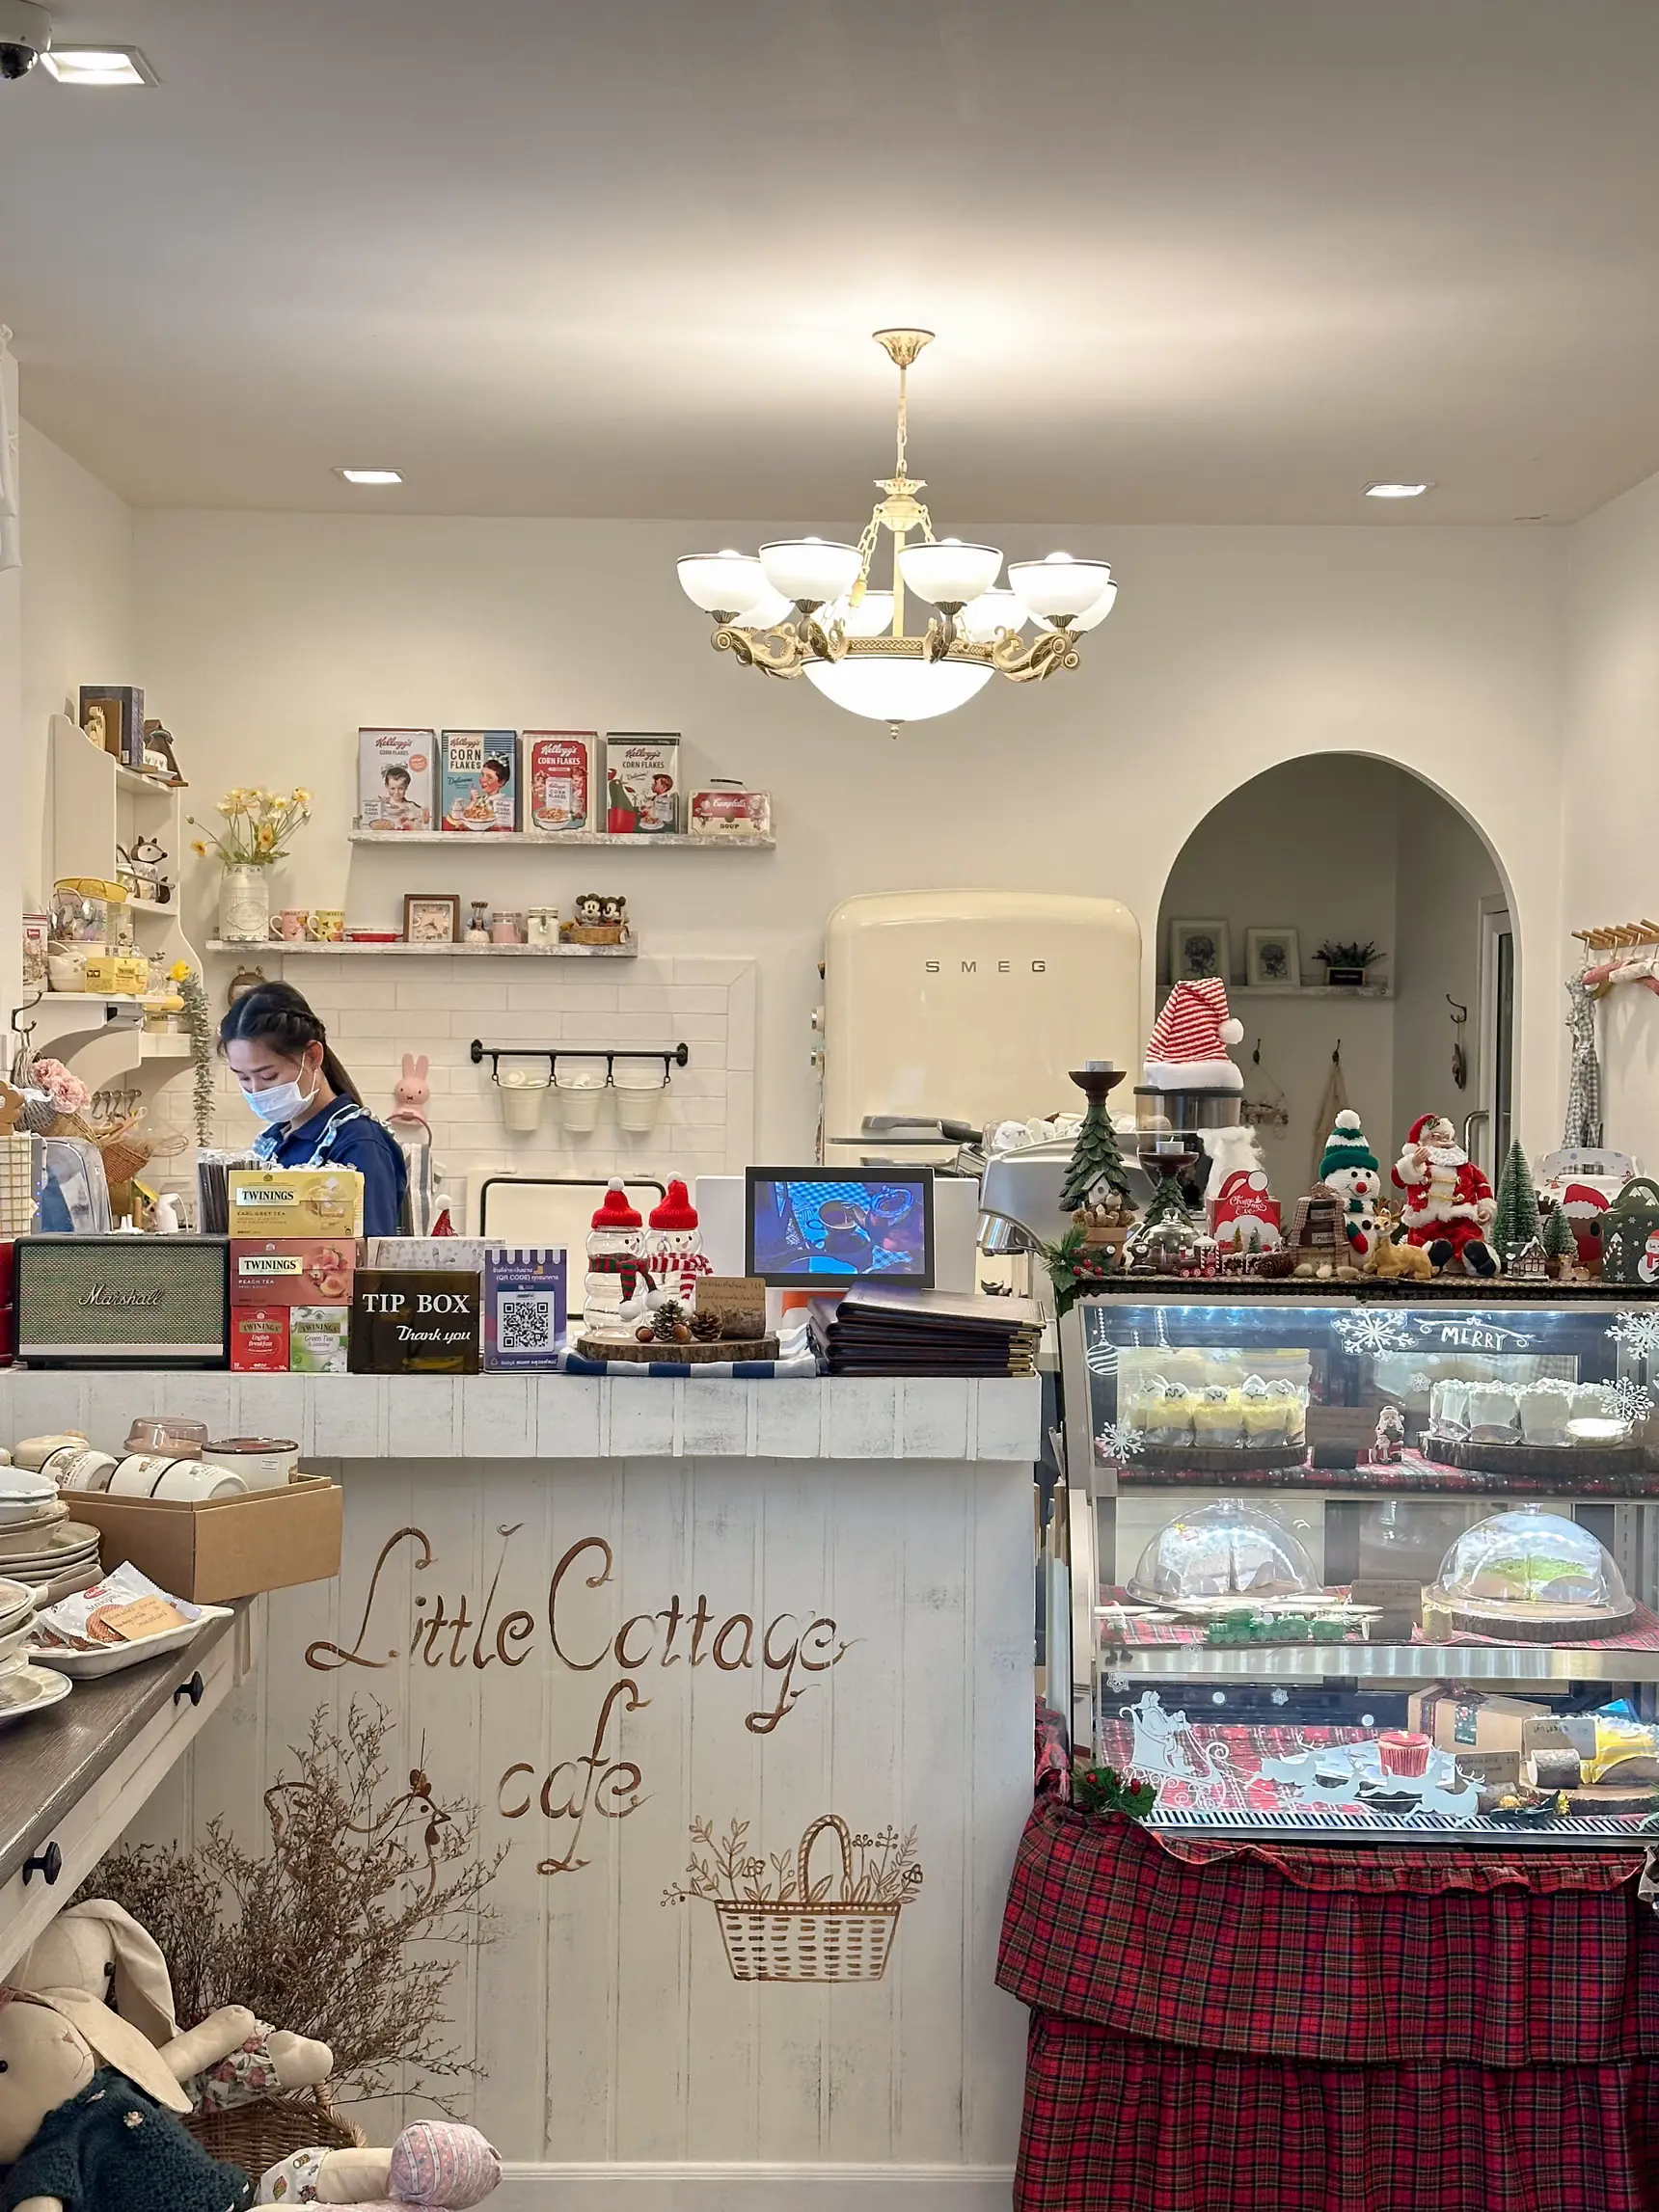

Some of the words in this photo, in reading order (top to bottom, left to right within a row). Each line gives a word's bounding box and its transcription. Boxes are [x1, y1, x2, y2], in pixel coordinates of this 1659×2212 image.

[375, 736, 413, 749] Kellogg's
[449, 737, 479, 748] Kellogg's
[450, 748, 481, 761] CORN
[540, 743, 578, 757] Kellogg's
[625, 747, 661, 761] Kellogg's
[450, 761, 481, 769] FLAKES
[925, 960, 1046, 973] SMEG
[242, 1191, 294, 1200] TWININGS
[244, 1260, 296, 1270] TWININGS
[78, 1283, 164, 1306] Marshall
[362, 1294, 405, 1313] TIP
[416, 1294, 471, 1313] BOX
[243, 1323, 280, 1332] TWININGS
[301, 1323, 337, 1333] TWININGS
[395, 1325, 443, 1341] Thank
[443, 1331, 471, 1344] you
[1441, 1326, 1509, 1351] MERRY
[304, 1522, 534, 1671] Little
[548, 1535, 866, 1734] Cottage
[497, 1679, 661, 1876] cafe
